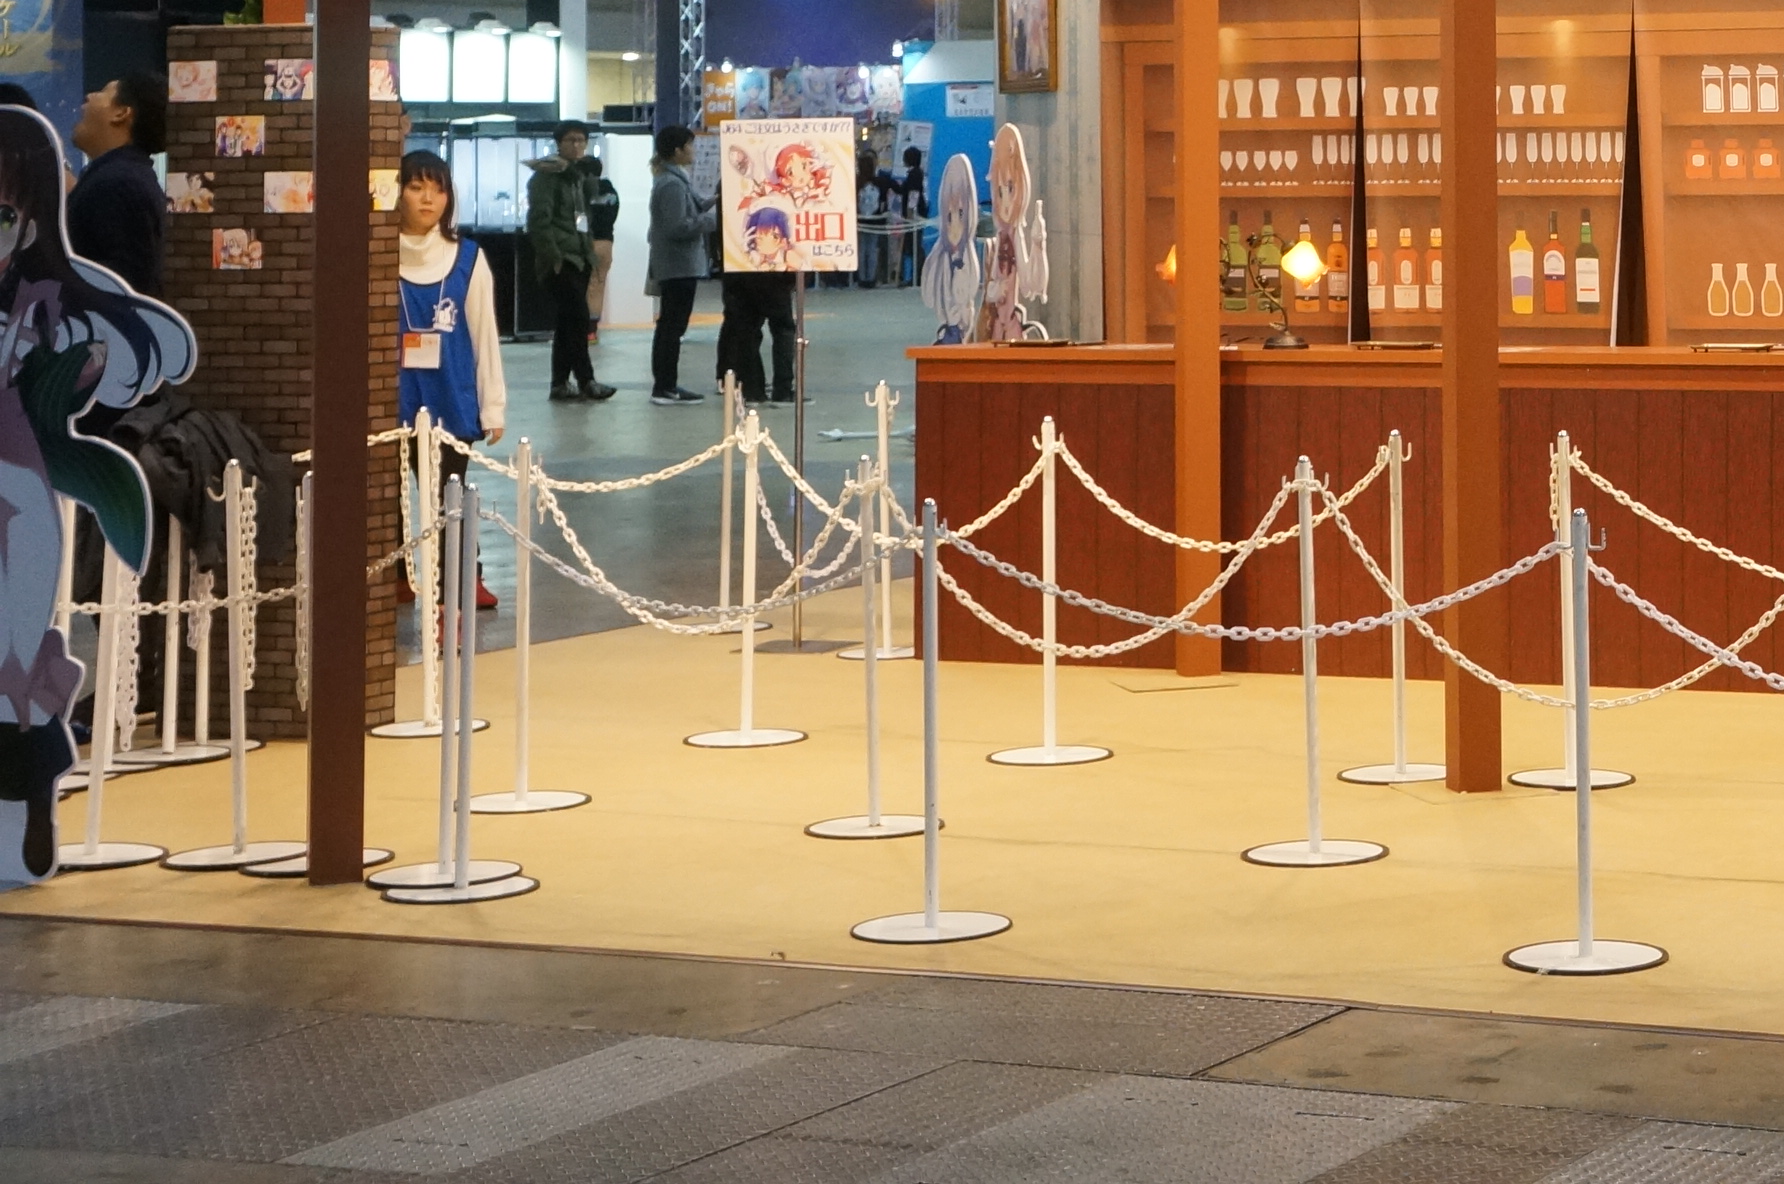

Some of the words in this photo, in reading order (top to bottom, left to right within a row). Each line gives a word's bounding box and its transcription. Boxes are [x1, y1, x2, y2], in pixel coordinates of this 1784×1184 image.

[794, 211, 845, 242] 出口
[812, 245, 855, 257] はこちら
